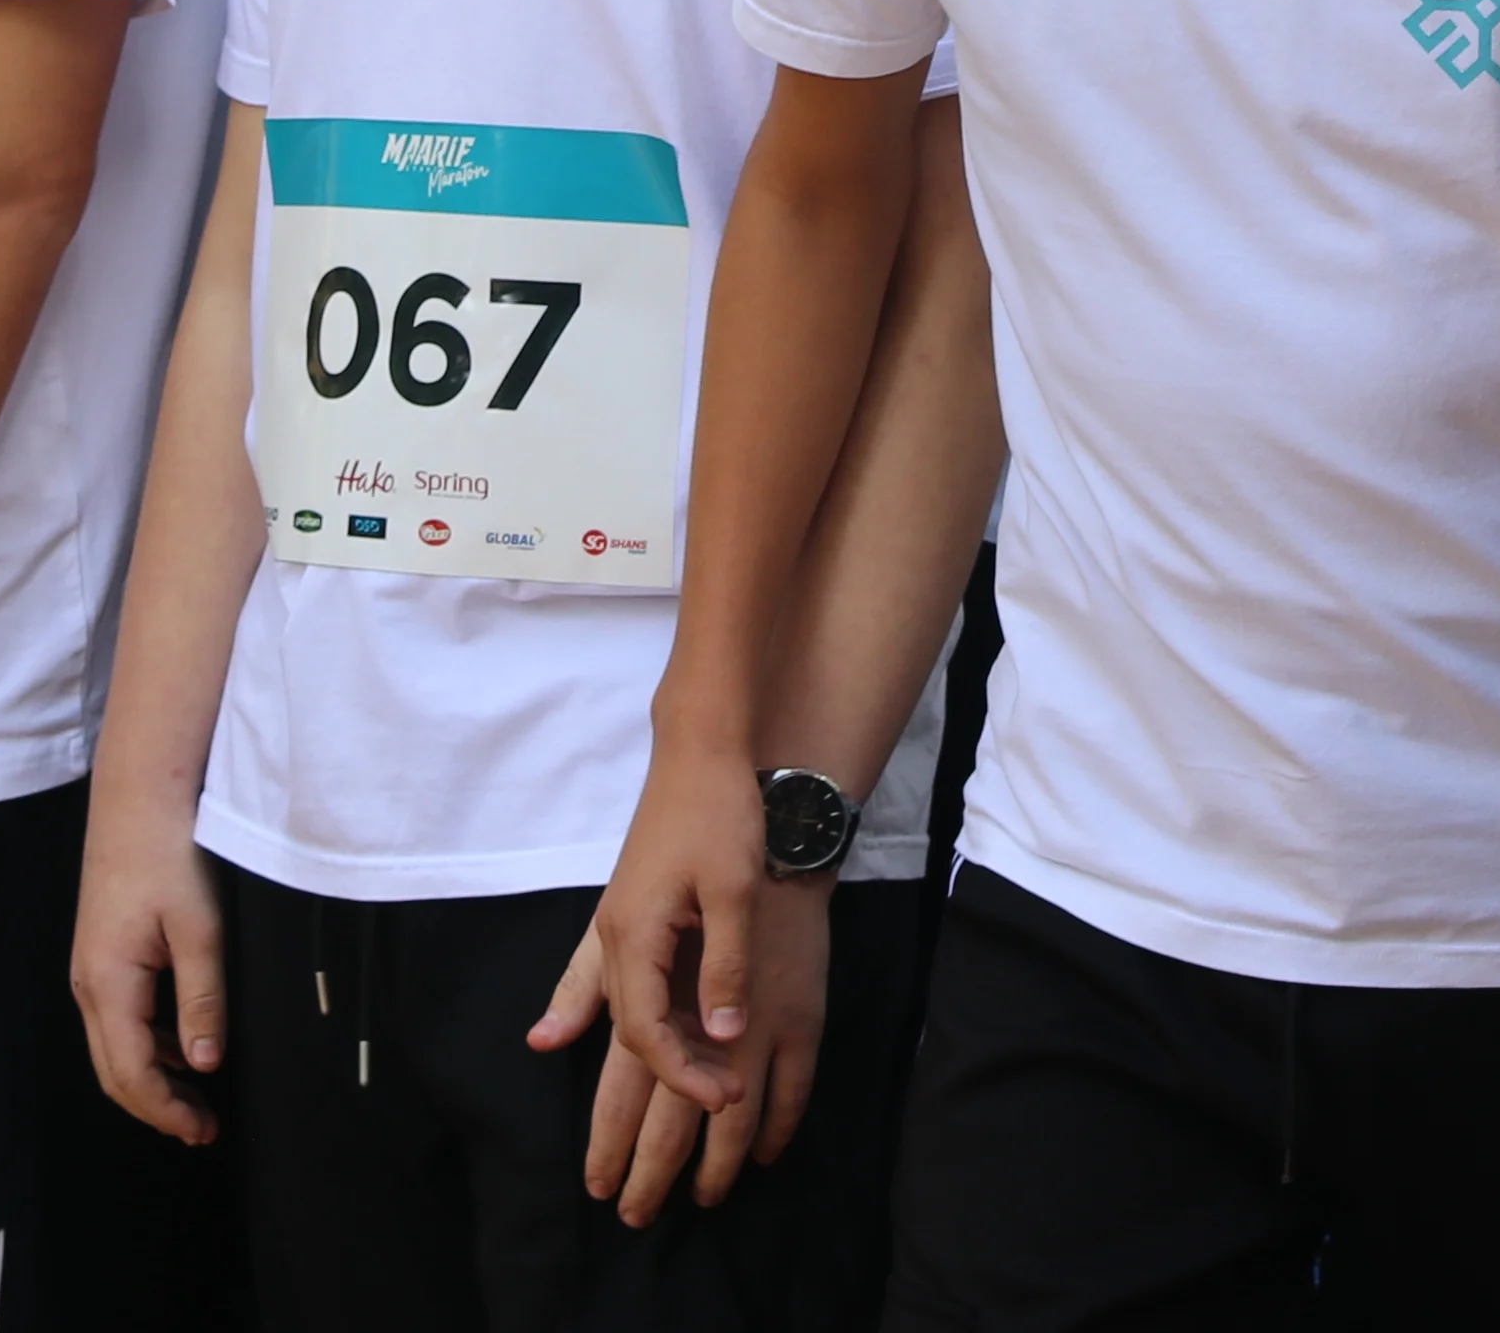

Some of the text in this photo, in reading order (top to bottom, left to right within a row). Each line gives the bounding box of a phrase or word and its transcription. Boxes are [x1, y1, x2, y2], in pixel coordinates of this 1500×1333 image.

[381, 133, 476, 171] MAARIF
[306, 266, 582, 411] 067
[335, 460, 489, 500] Hako Spring
[486, 533, 535, 546] GLOBAL
[610, 539, 647, 549] SHANS
